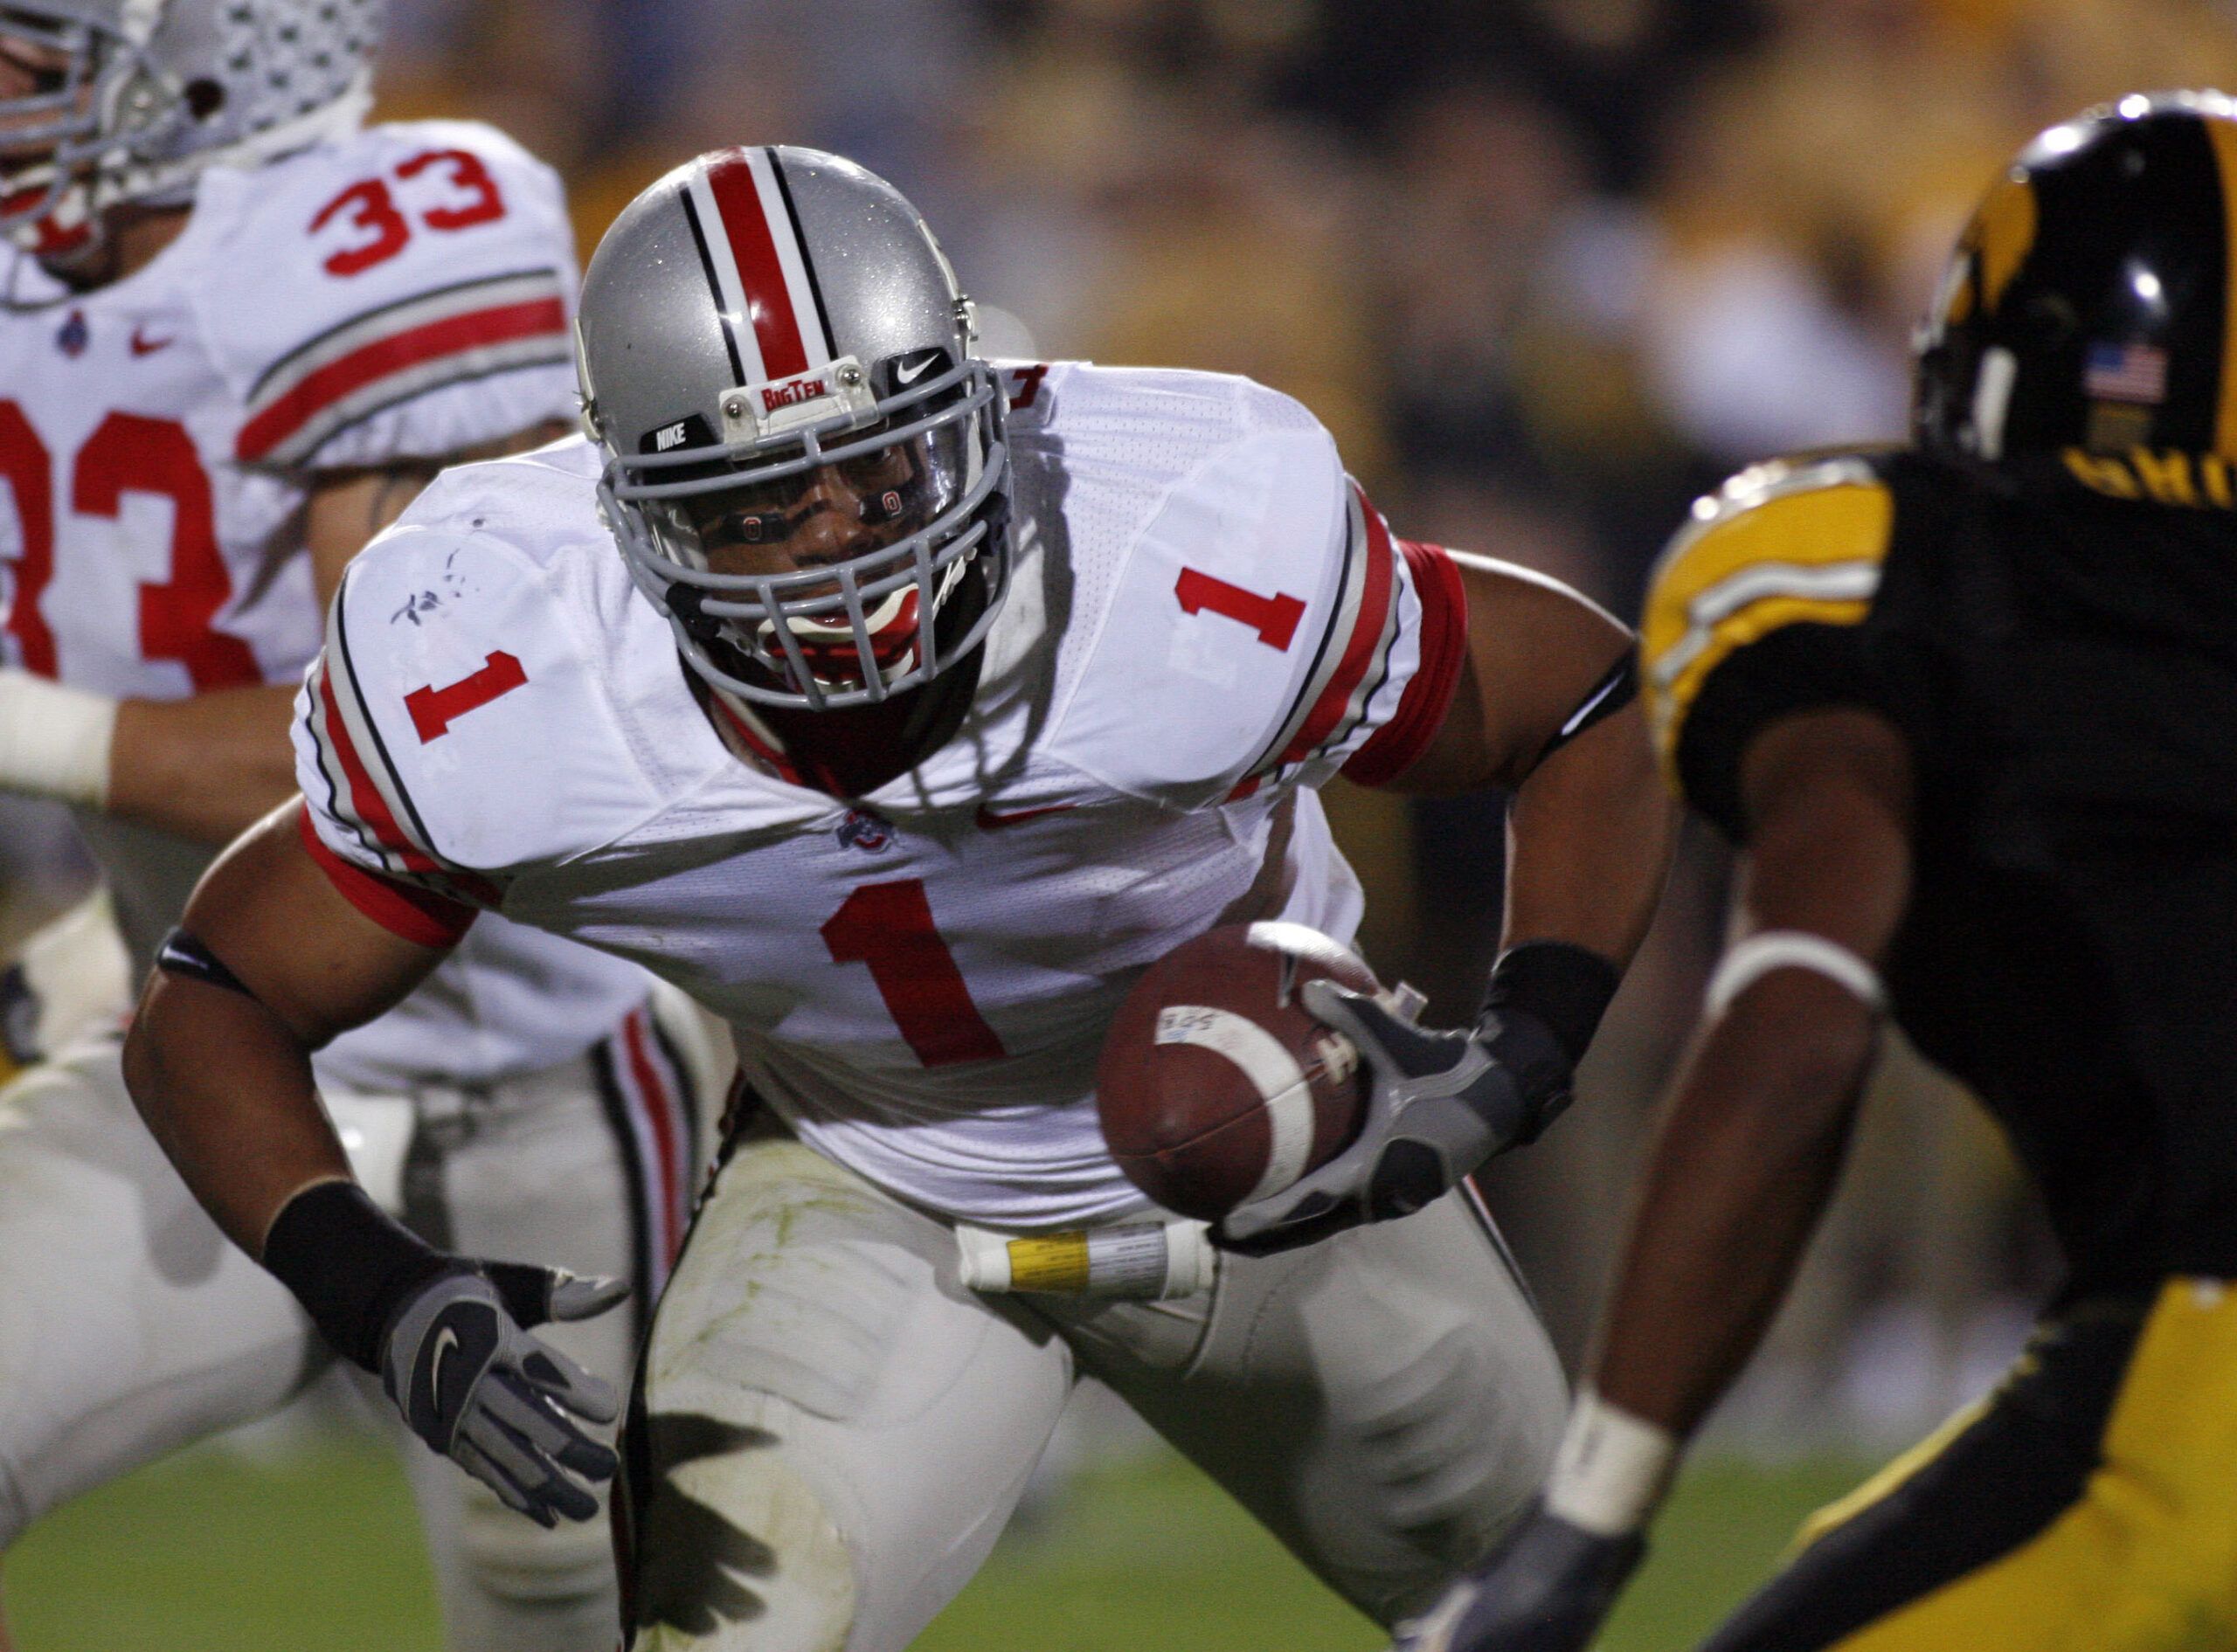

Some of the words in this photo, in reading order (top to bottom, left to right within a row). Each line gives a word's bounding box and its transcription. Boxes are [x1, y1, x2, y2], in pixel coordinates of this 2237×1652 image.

[308, 149, 505, 278] 33
[656, 422, 686, 452] NIKE
[1174, 566, 1307, 653] 1
[404, 650, 529, 745] 1
[819, 878, 1008, 1068] 1
